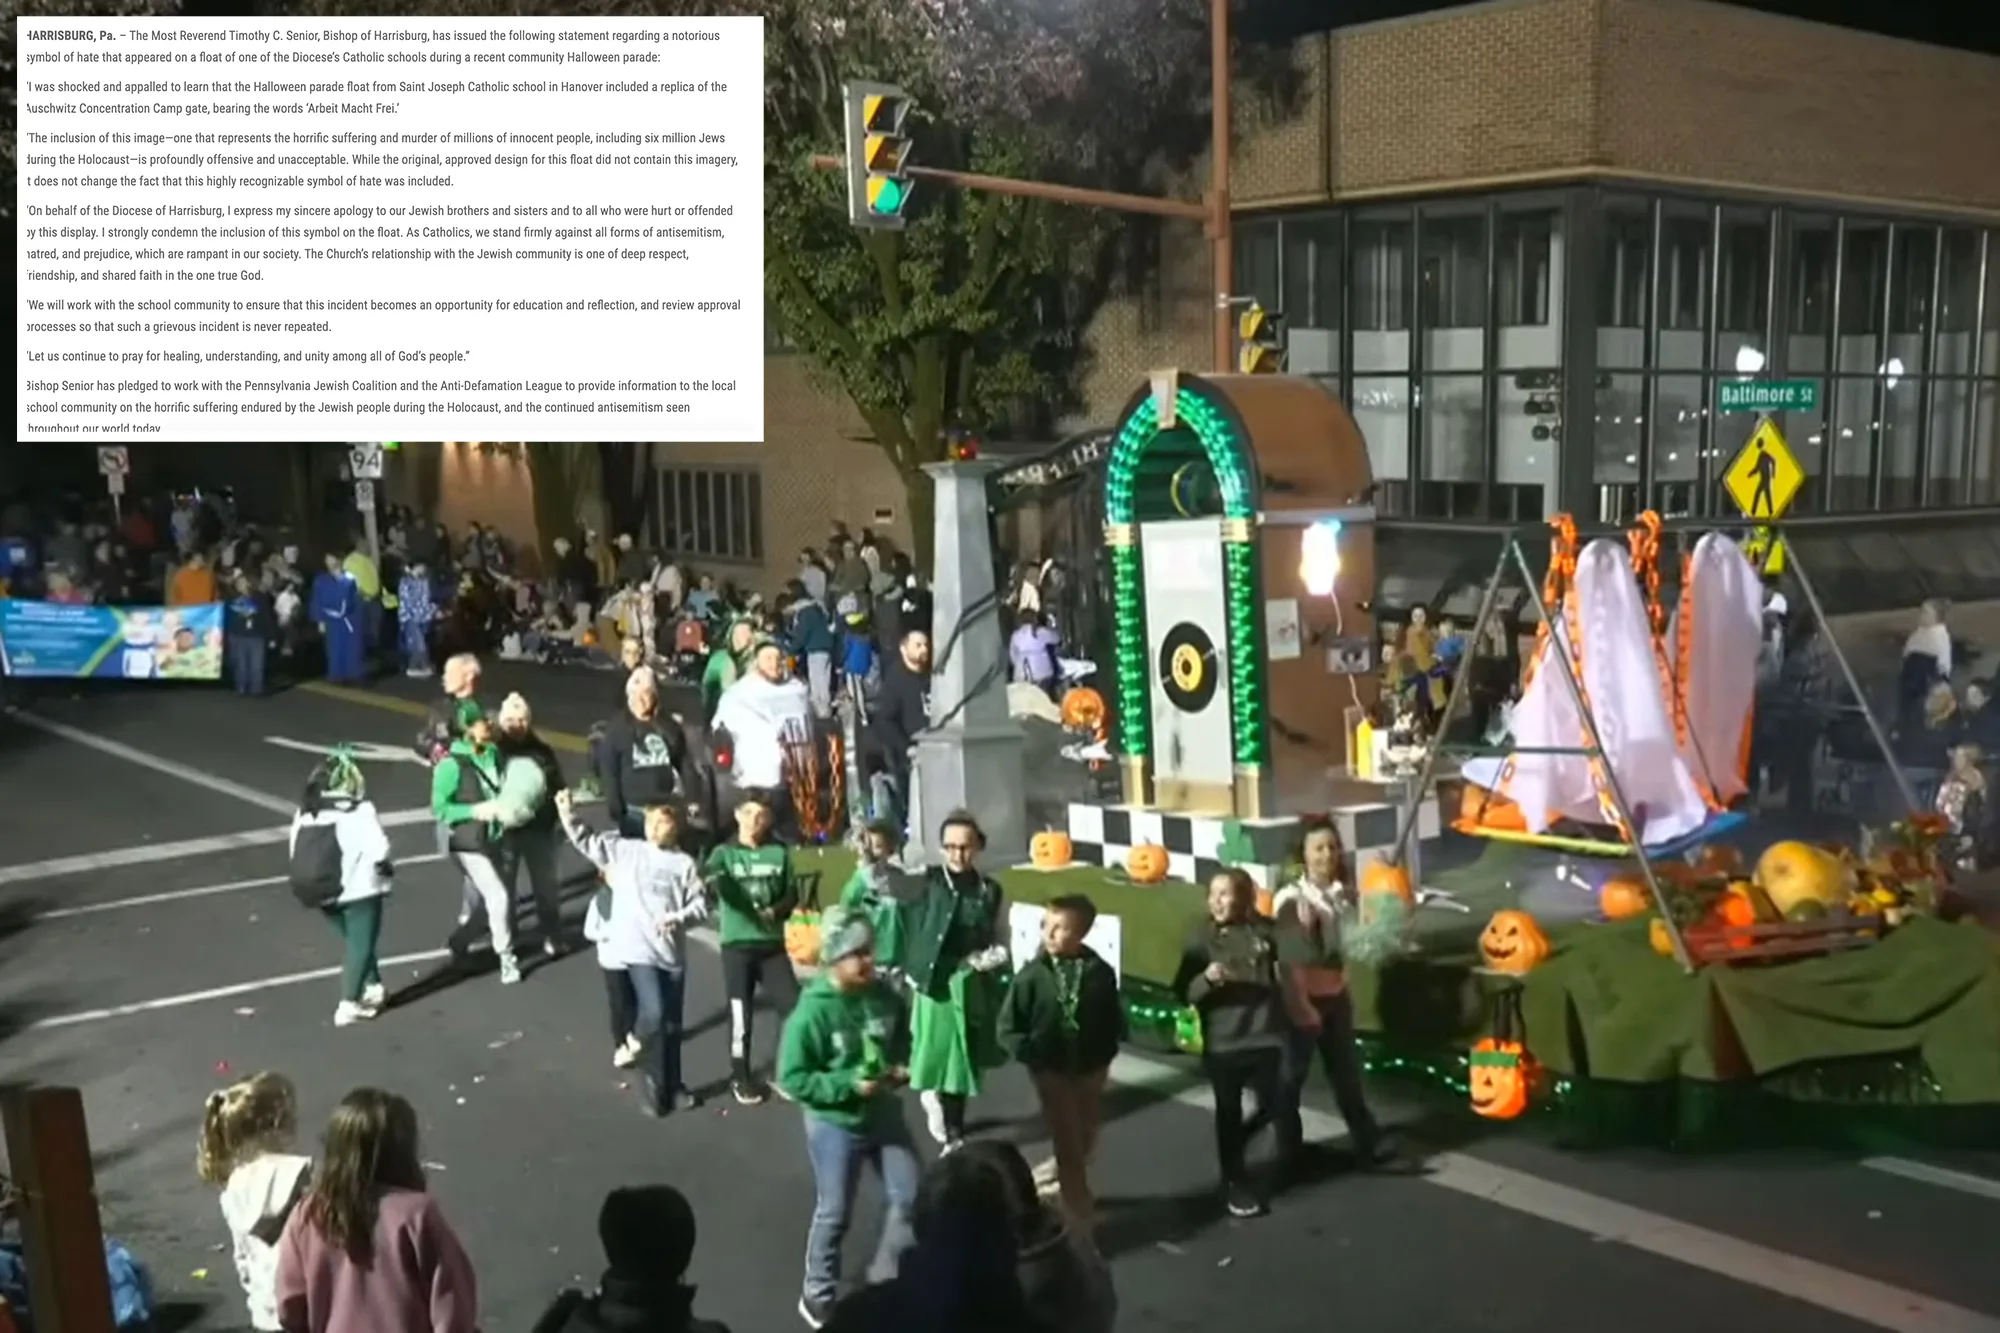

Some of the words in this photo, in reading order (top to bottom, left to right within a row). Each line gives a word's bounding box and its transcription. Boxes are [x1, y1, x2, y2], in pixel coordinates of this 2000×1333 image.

[1721, 384, 1795, 404] Baltimore
[1800, 387, 1813, 403] St
[352, 451, 380, 470] 94
